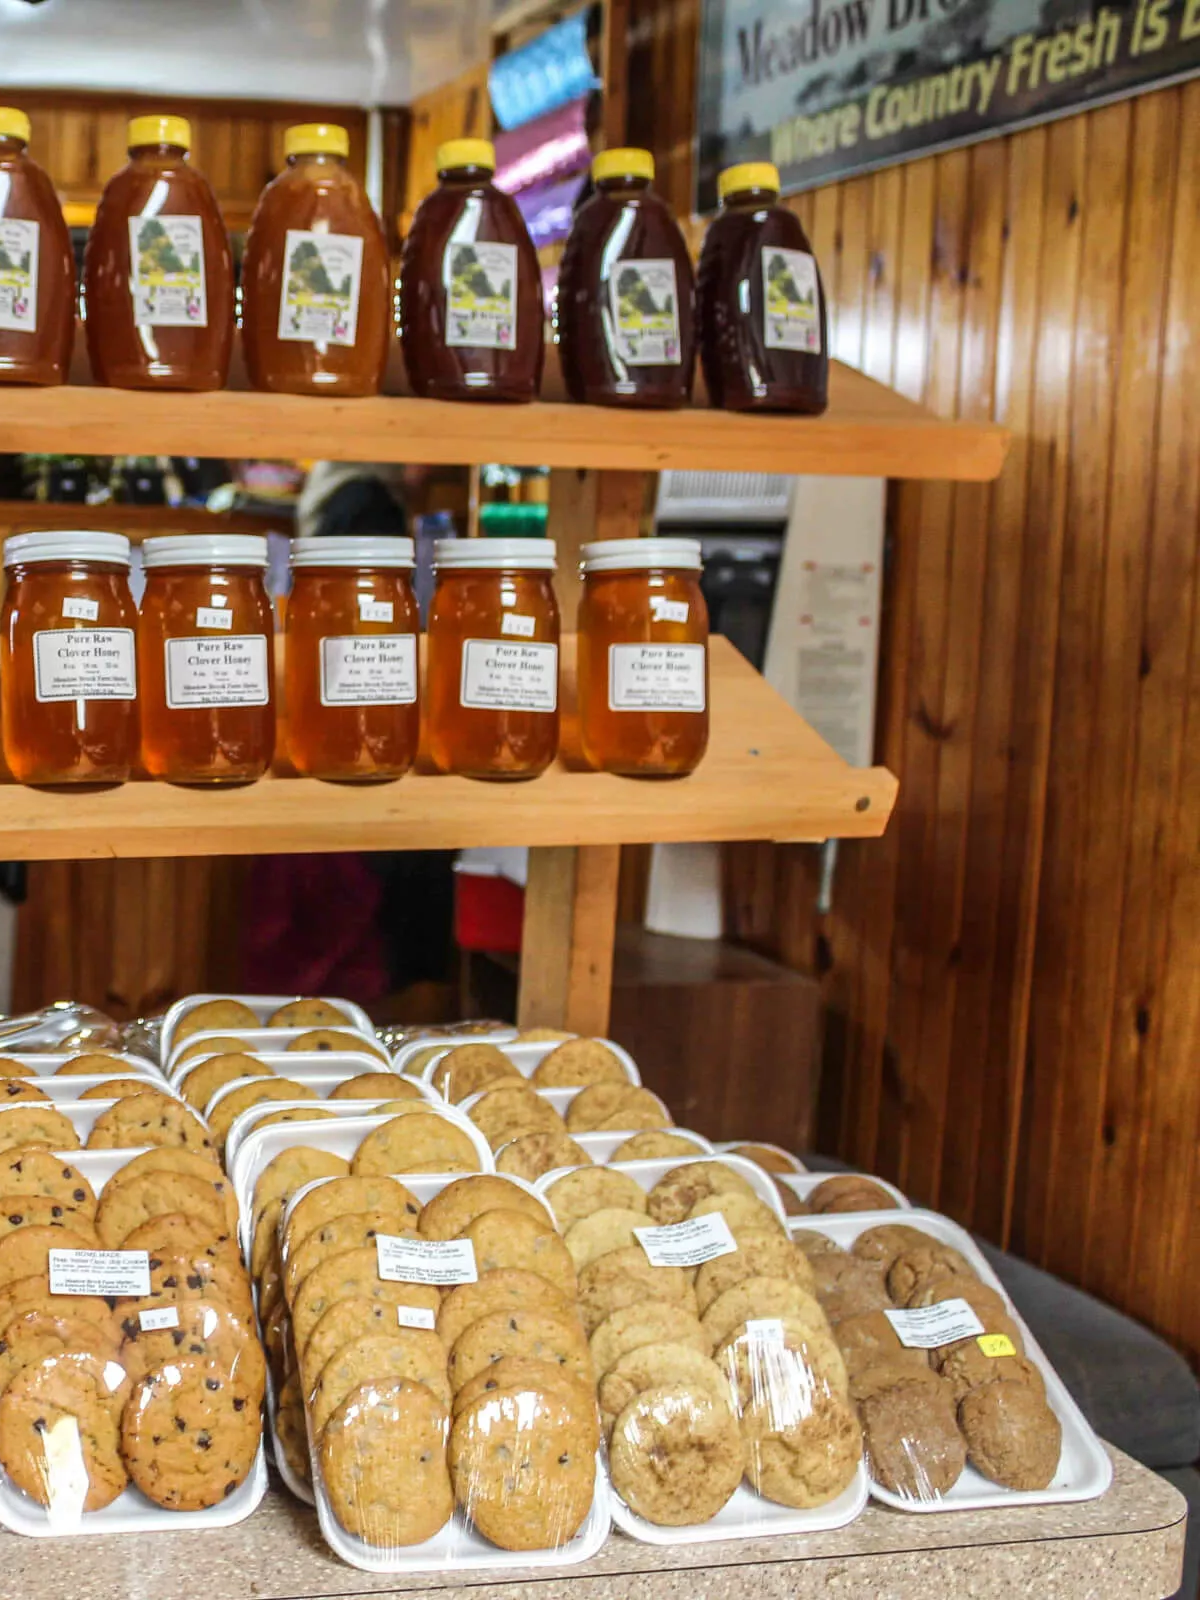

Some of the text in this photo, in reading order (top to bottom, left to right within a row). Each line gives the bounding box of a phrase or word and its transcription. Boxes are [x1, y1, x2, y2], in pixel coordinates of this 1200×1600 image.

[737, 0, 869, 84] Meadow
[770, 102, 861, 168] Where
[865, 54, 1000, 140] Country
[1006, 7, 1121, 96] Fresh
[67, 634, 112, 644] Pure Raw
[197, 642, 243, 652] Pure Raw
[58, 648, 120, 659] Clover Honey
[344, 654, 376, 663] Clover
[188, 656, 251, 666] Clover Honey
